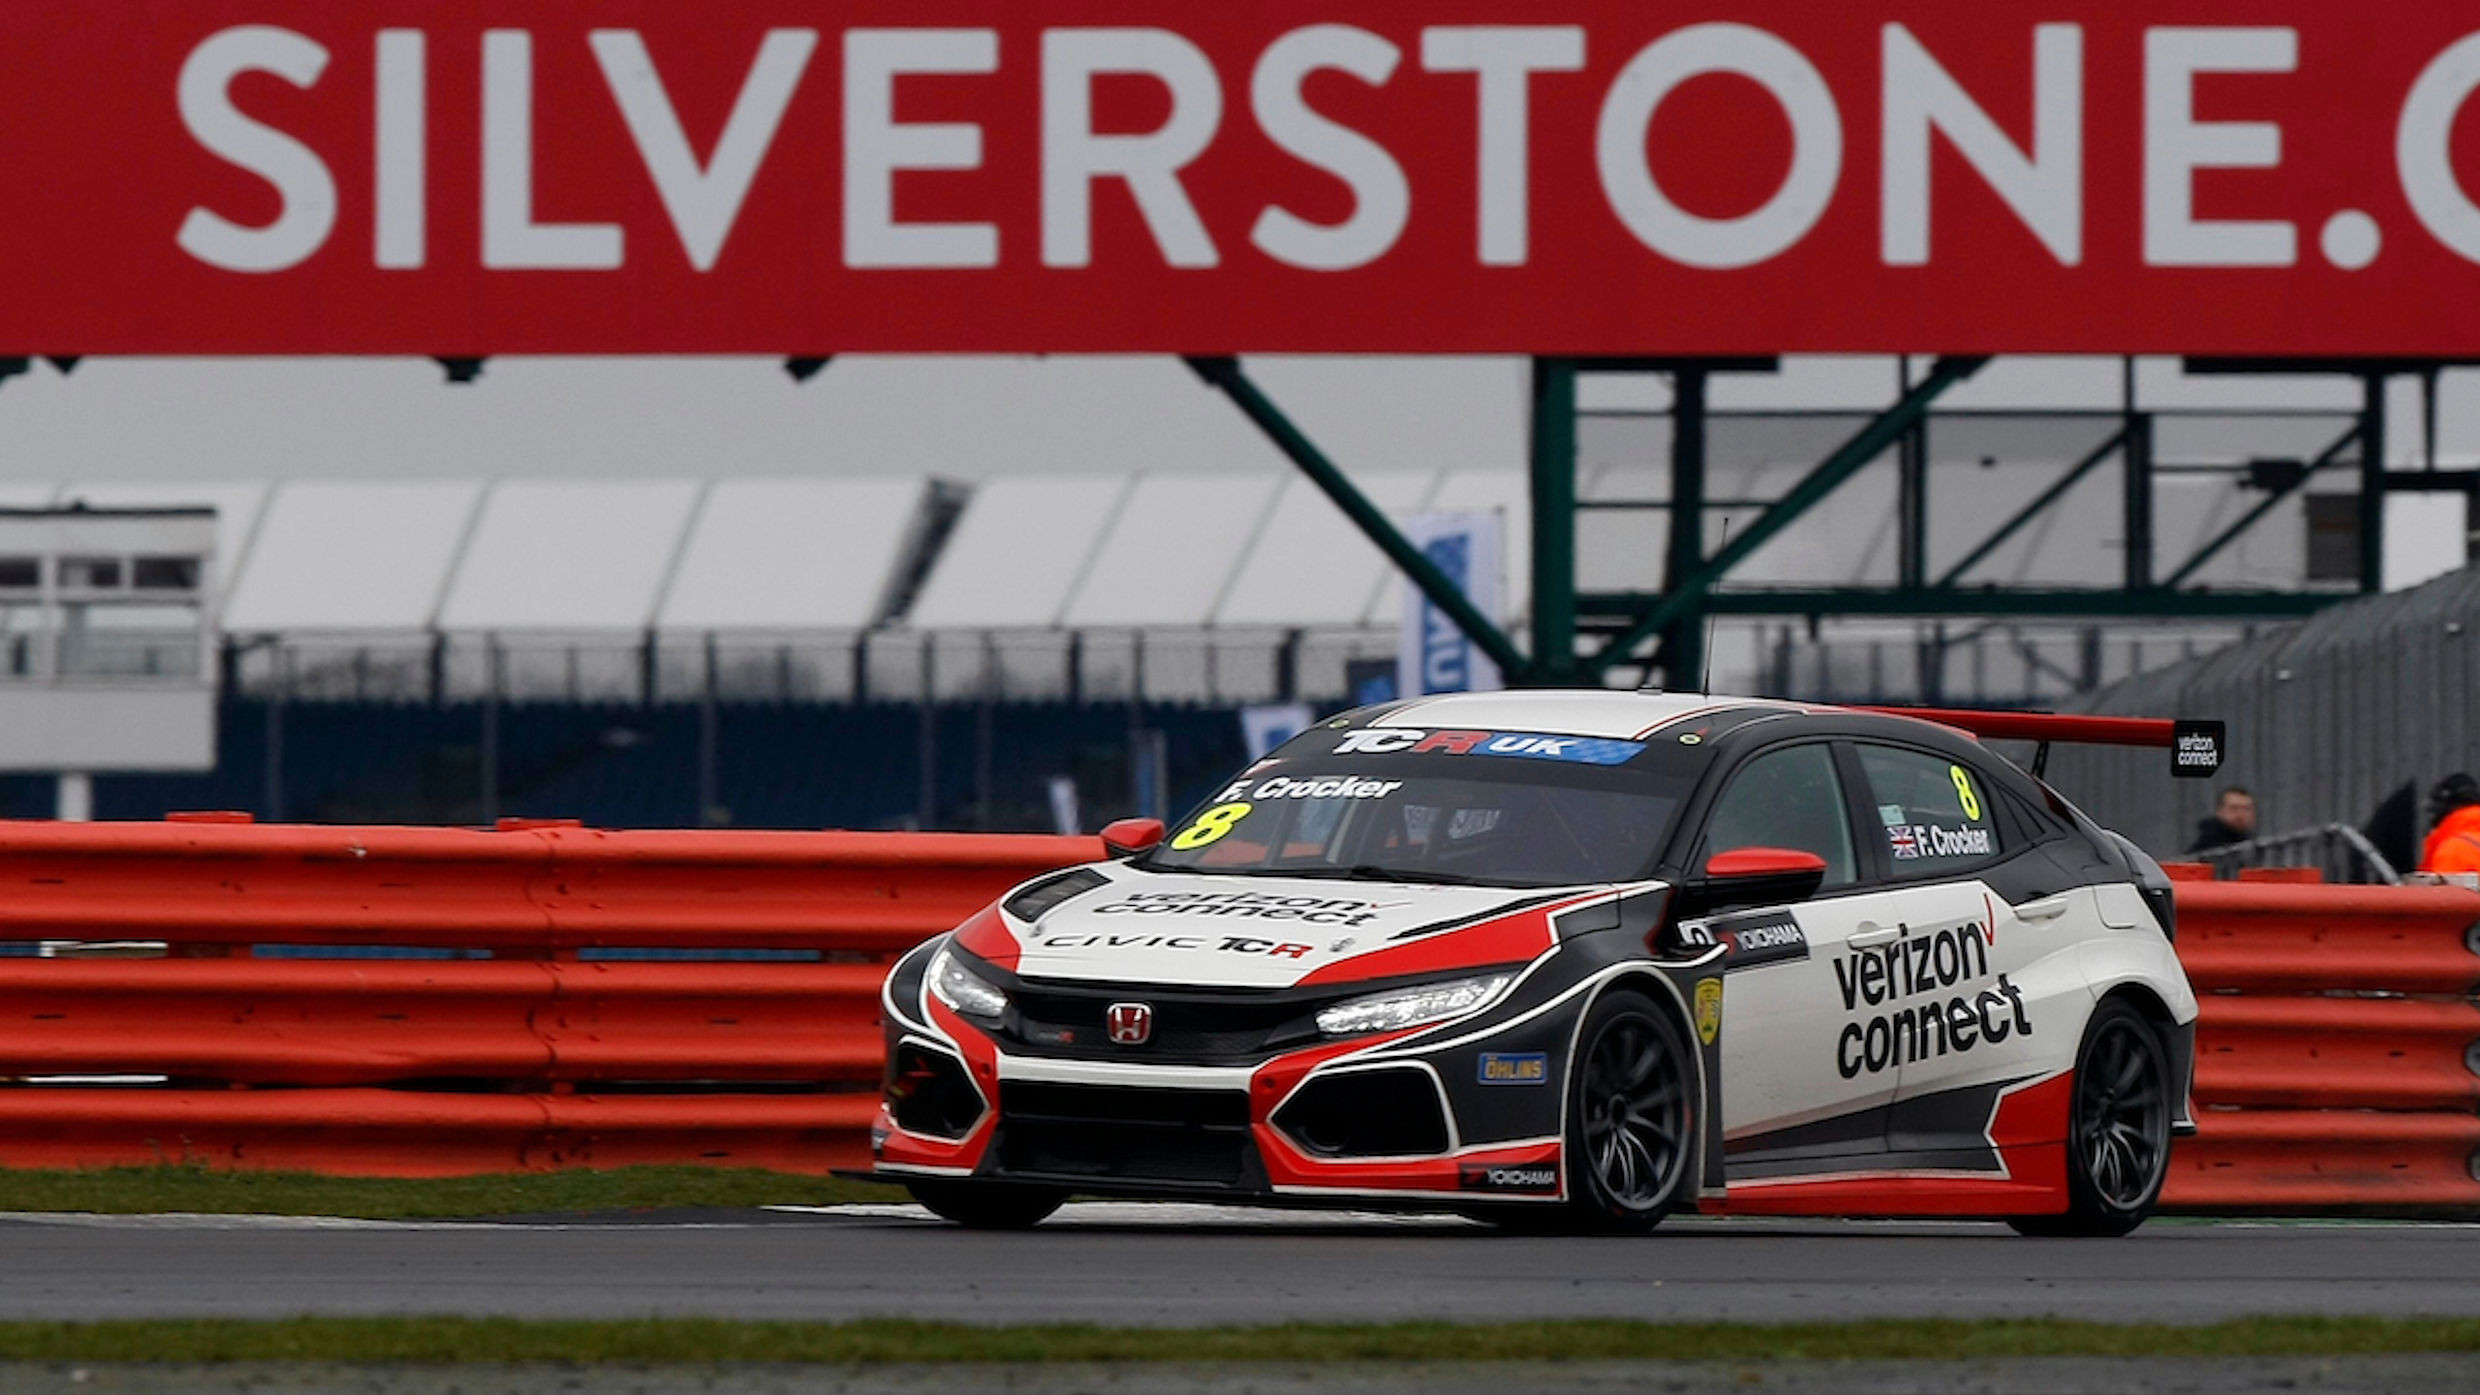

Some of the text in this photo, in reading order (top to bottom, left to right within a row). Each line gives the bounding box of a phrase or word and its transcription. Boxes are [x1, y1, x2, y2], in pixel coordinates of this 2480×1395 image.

[1333, 728, 1579, 757] TCR UK
[1252, 775, 1402, 800] Crocker
[1950, 764, 1980, 821] 8
[1171, 802, 1254, 851] 8
[1930, 823, 1990, 856] Crocker
[1094, 902, 1379, 927] connect
[1126, 891, 1367, 912] verizon
[1043, 934, 1315, 959] CIVIC TCR
[1733, 922, 1804, 951] YOKOHAMA
[1833, 922, 1988, 1011] verizon
[1837, 973, 2033, 1080] connect
[1484, 1056, 1543, 1080] ÖHLINS
[1487, 1169, 1556, 1186] YOKOHAMA
